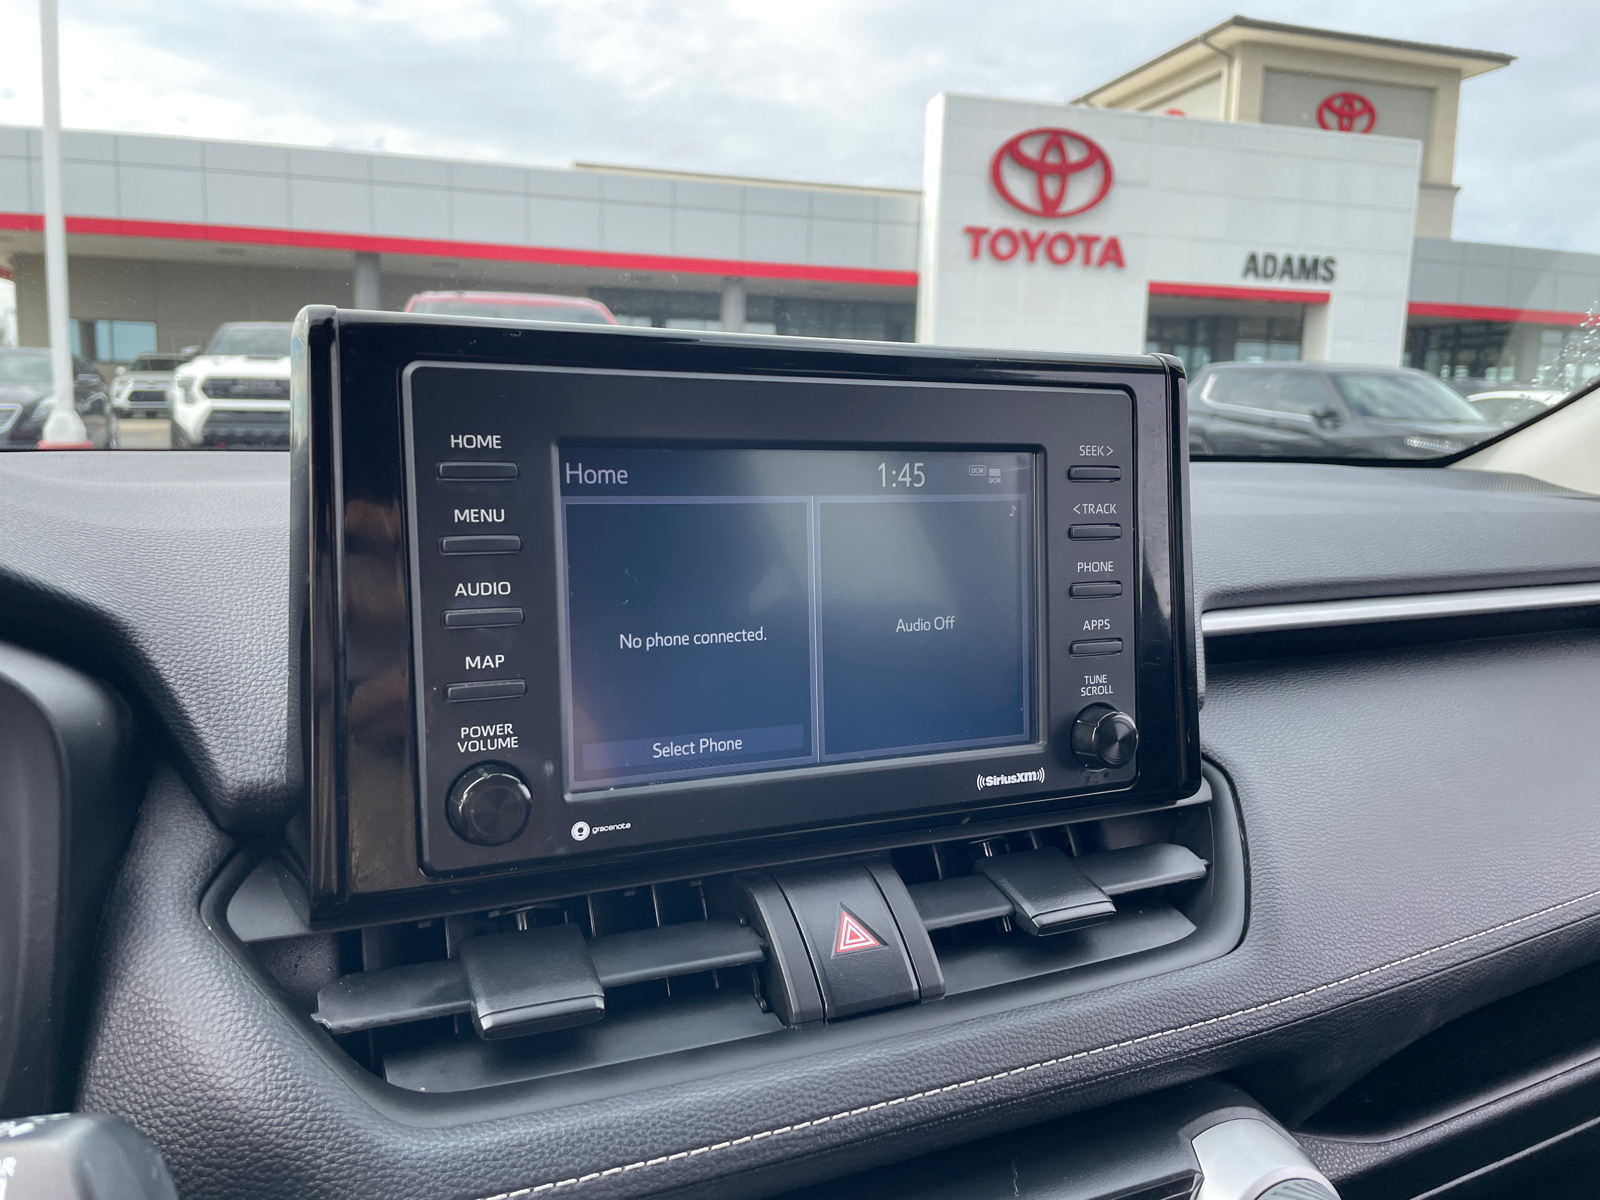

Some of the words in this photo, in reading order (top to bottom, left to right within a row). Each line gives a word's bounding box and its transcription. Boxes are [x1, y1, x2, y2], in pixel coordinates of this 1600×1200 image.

[963, 225, 1127, 269] TOYOTA
[1242, 251, 1337, 282] ADAMS
[450, 434, 502, 449] HOME
[565, 463, 628, 484] Home
[878, 462, 926, 488] 1:45
[454, 508, 505, 523] MENU
[1077, 561, 1114, 573] PHONE
[454, 581, 511, 597] AUDIO
[896, 618, 931, 633] Audio
[933, 615, 956, 631] Off
[1082, 619, 1111, 631] APPS
[619, 633, 642, 649] No
[646, 632, 690, 651] phone
[693, 626, 767, 645] connected.
[465, 654, 505, 670] MAP
[1084, 674, 1108, 685] TUNE
[1080, 685, 1114, 697] SCROLL
[460, 723, 514, 739] POWER
[457, 736, 519, 753] VOLUME
[653, 741, 695, 758] Select
[700, 738, 743, 753] Phone
[592, 822, 632, 835] gracenote
